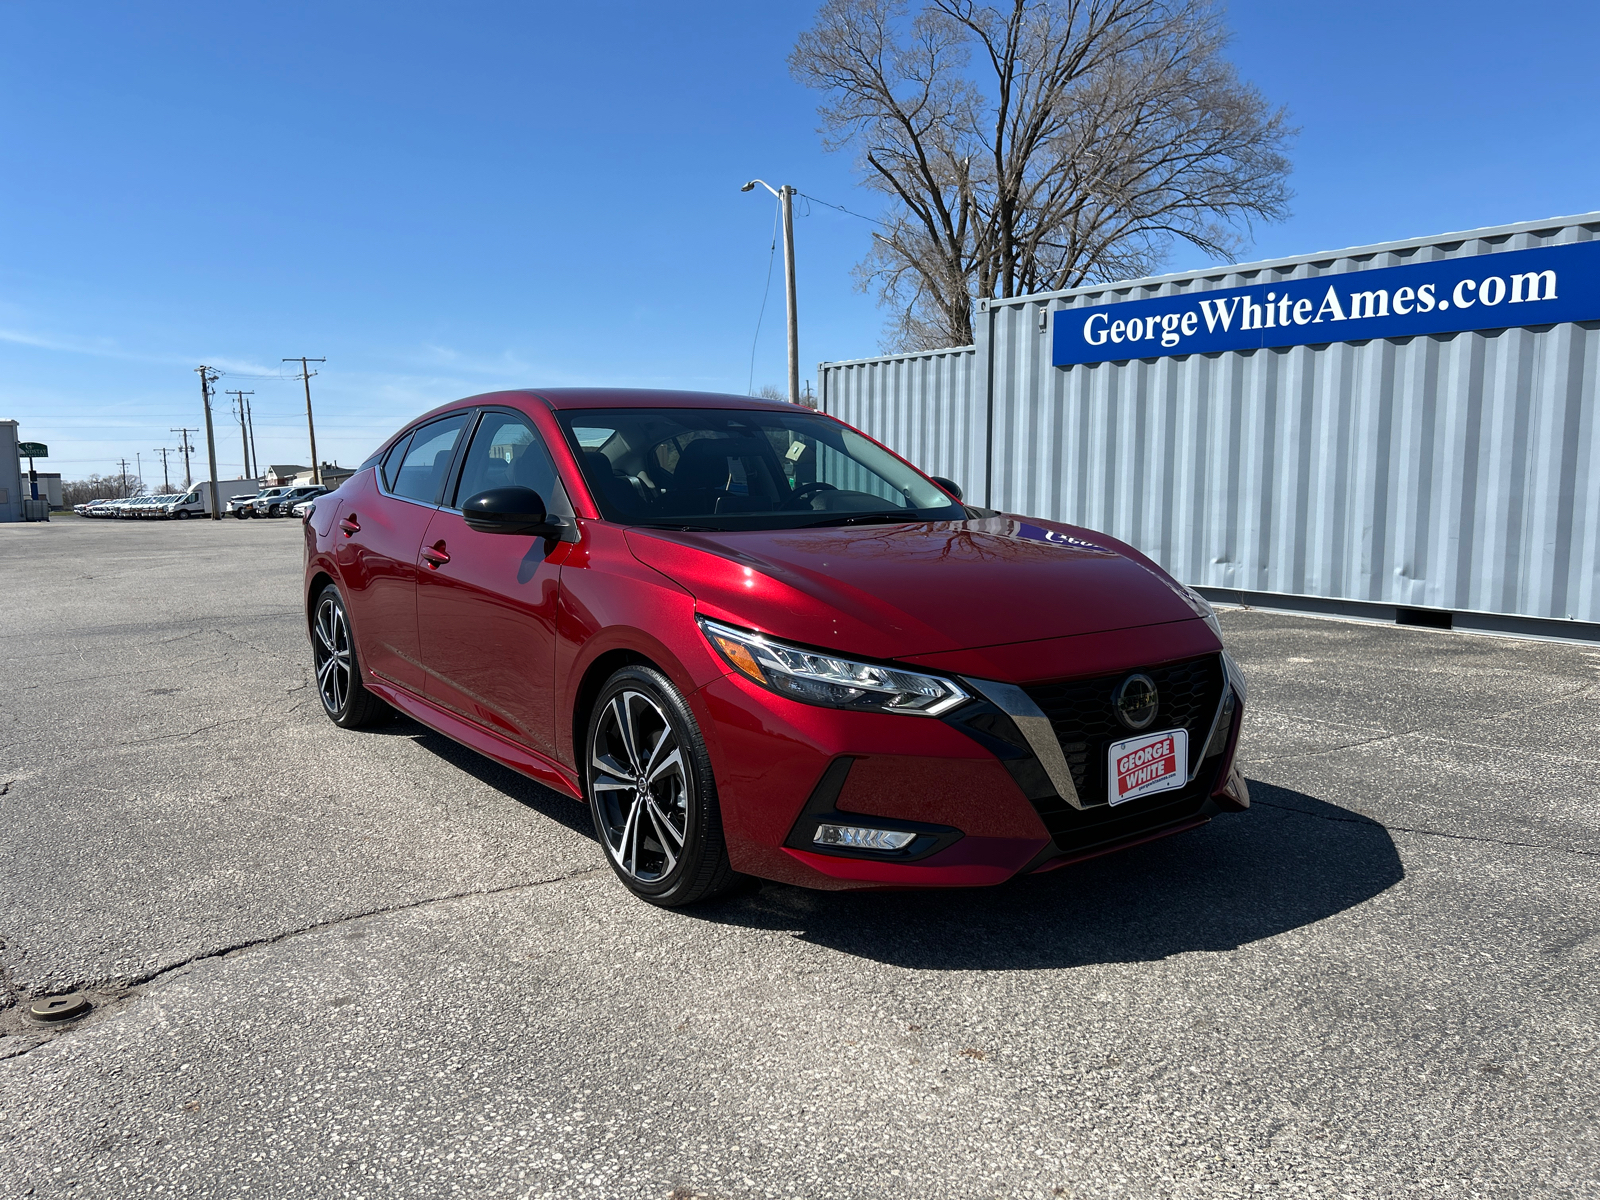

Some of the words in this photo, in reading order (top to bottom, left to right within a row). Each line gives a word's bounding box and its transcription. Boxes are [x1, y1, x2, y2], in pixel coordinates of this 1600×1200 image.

[1083, 269, 1558, 346] GeorgeWhiteAmes.com
[1120, 740, 1170, 773] GEORGE
[1126, 760, 1165, 789] WHITE
